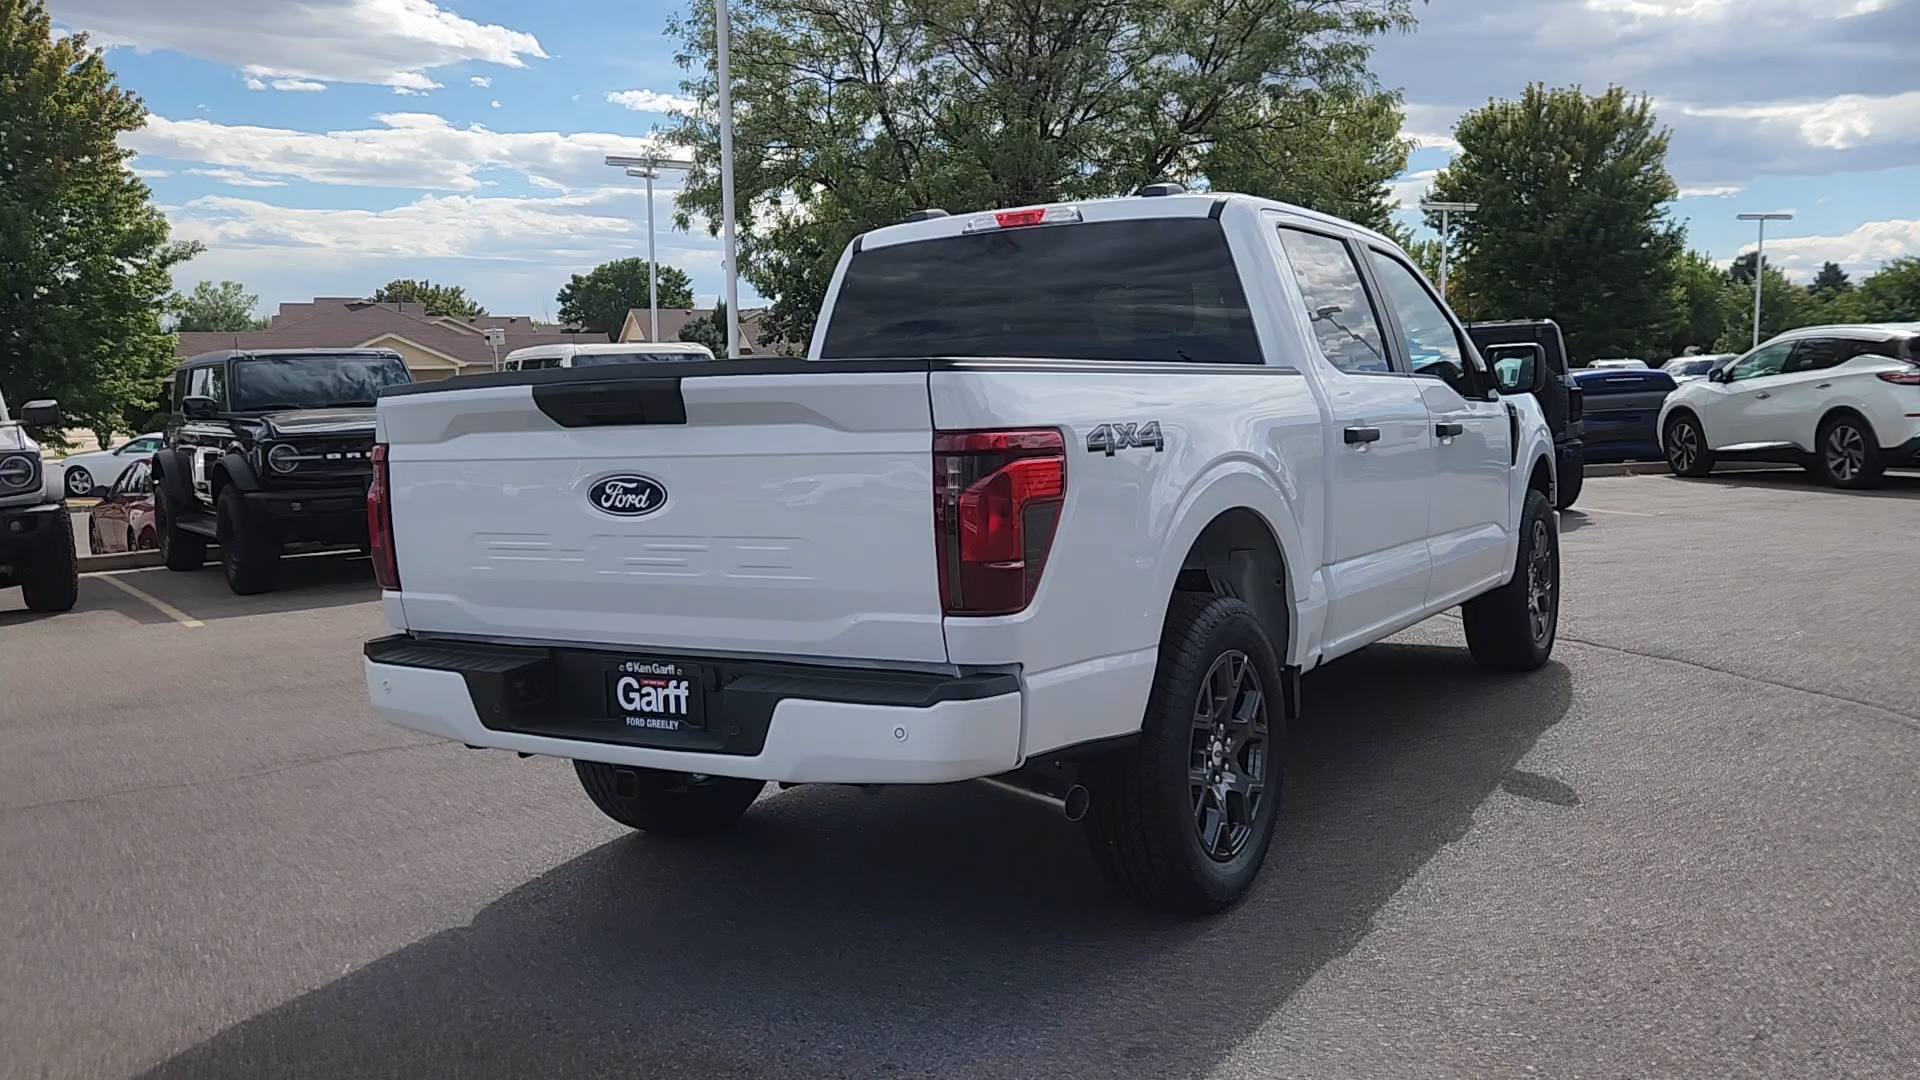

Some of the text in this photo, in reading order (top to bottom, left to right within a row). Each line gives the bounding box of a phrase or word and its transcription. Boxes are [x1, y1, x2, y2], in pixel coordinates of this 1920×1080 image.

[601, 481, 650, 508] Ford
[633, 661, 675, 676] Ken Garff
[617, 676, 689, 715] Garff
[626, 716, 679, 730] FORD GREELEY
